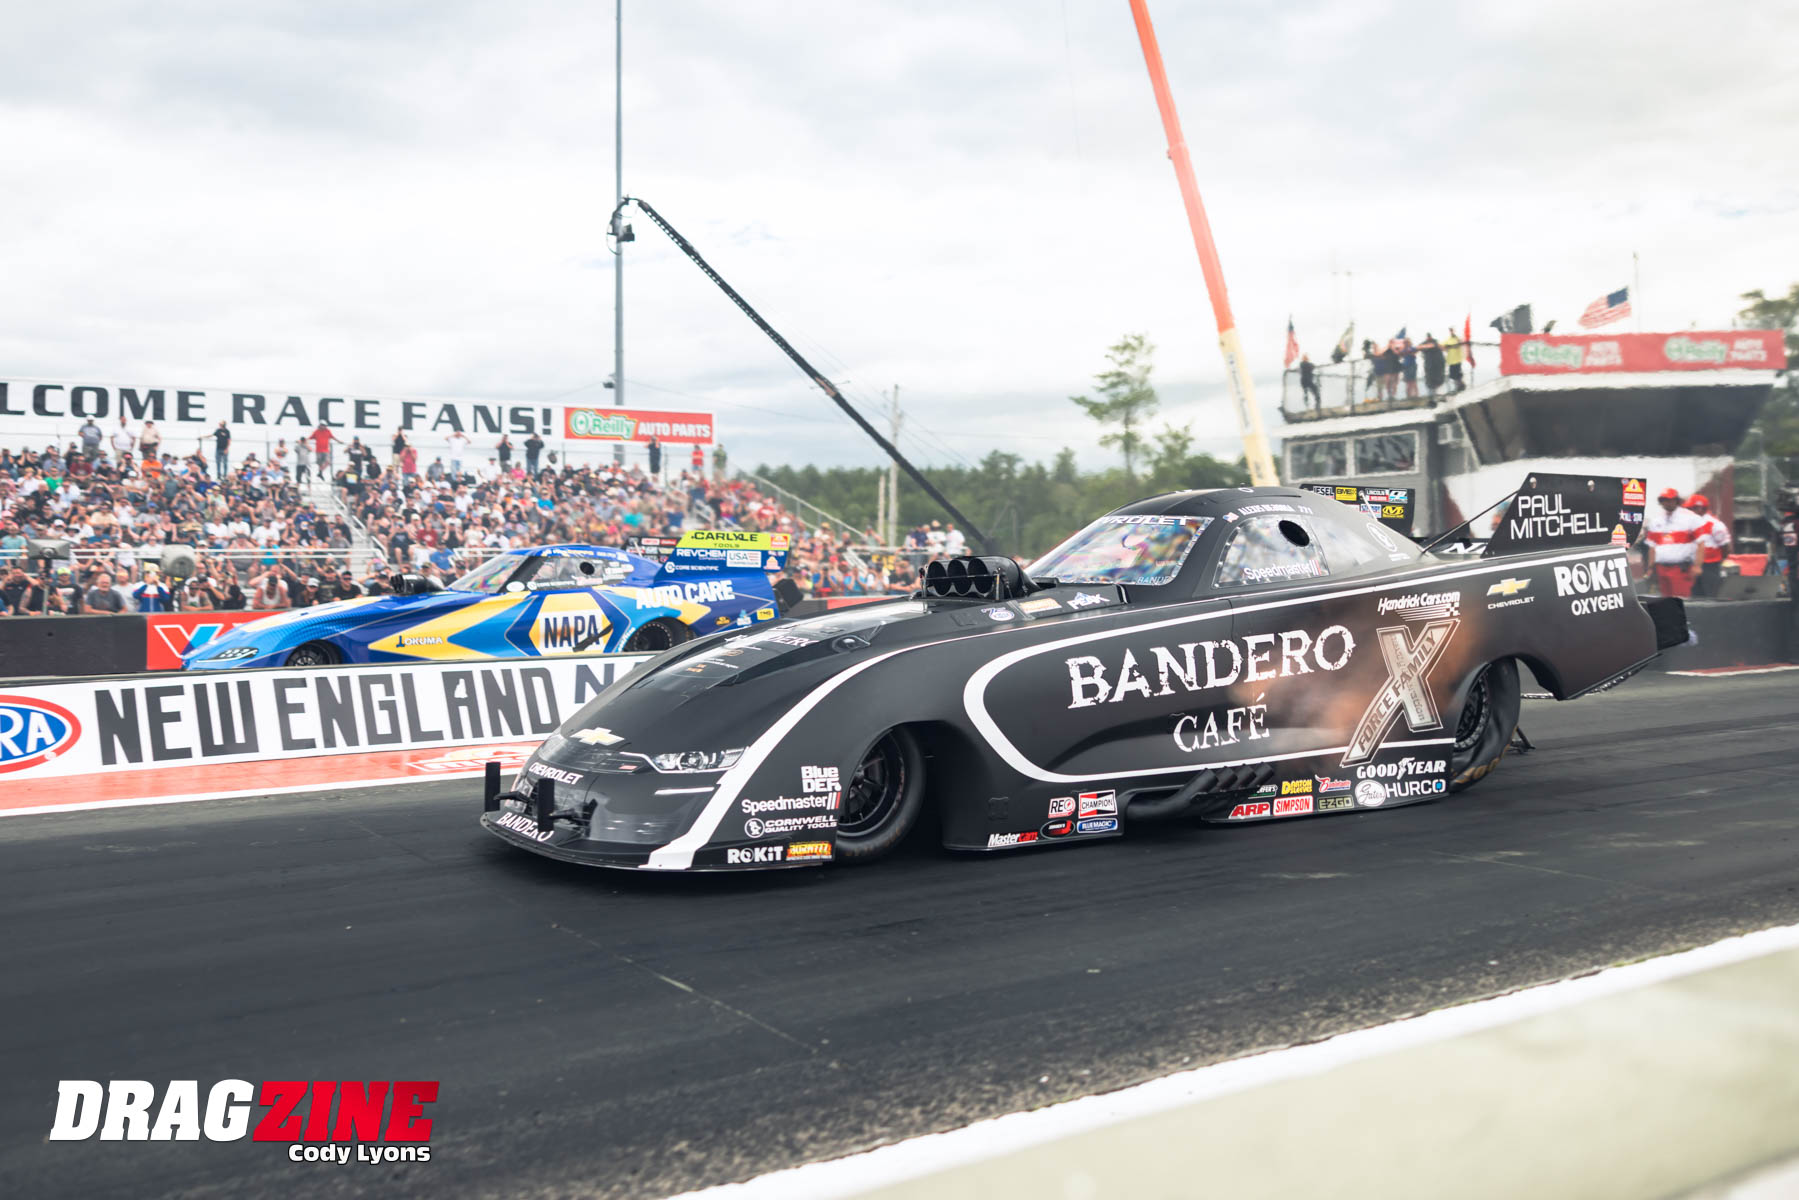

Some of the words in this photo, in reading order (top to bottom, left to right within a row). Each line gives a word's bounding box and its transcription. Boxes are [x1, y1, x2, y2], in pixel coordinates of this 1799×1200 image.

[232, 393, 381, 430] RACE
[401, 402, 553, 435] FANS!
[571, 410, 636, 440] O'Reilly
[637, 421, 671, 436] AUTO
[672, 423, 712, 438] PARTS
[1518, 494, 1571, 517] PAUL
[1510, 512, 1608, 540] MITCHELL
[692, 531, 758, 543] CARLYLE
[676, 549, 726, 558] REVCHEM
[729, 552, 749, 561] USA
[1243, 562, 1314, 581] Speedmaster
[636, 584, 684, 610] AUTO
[684, 579, 736, 603] CARE
[1487, 596, 1535, 610] CHEVROLET
[1571, 592, 1625, 616] OXYGEN
[404, 636, 443, 646] OKUMA
[544, 614, 601, 649] NAPA
[1064, 624, 1357, 710] BANDERO
[1358, 692, 1395, 753] FORCE
[1391, 629, 1437, 698] FAMILY
[94, 681, 260, 767] NEW
[272, 666, 561, 751] ENGLAND
[1173, 693, 1270, 753] CAFÉ
[528, 761, 584, 785] CHEVROLET
[801, 765, 839, 778] Blue
[1356, 757, 1447, 780] GOODYEAR
[1384, 779, 1447, 798] HURCO
[741, 795, 828, 815] Speedmaster
[1081, 798, 1114, 810] CHAMPION
[1231, 803, 1270, 817] ARP
[1275, 797, 1310, 813] SIMPSON
[764, 825, 804, 834] QUALITY
[807, 821, 838, 830] TOOLS
[765, 815, 839, 828] CORNWELL
[987, 831, 1038, 847] Mastercam
